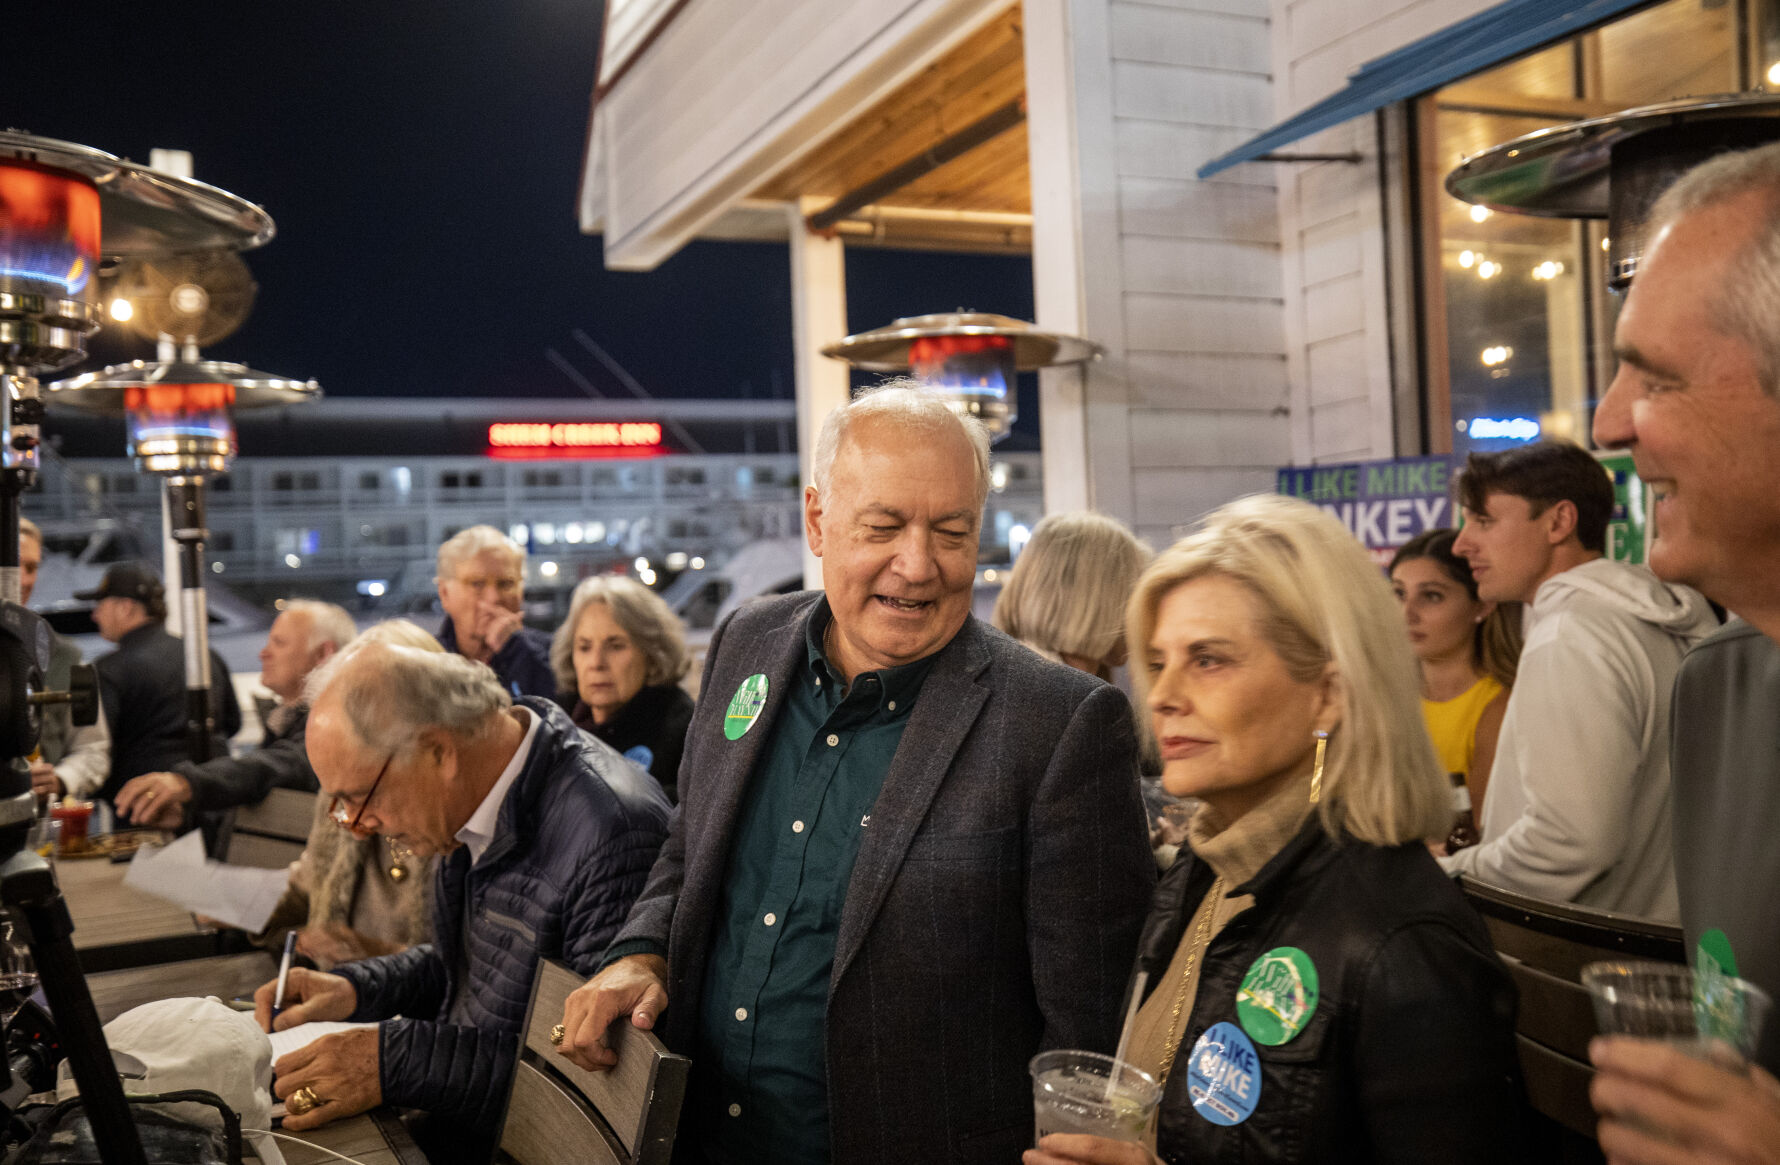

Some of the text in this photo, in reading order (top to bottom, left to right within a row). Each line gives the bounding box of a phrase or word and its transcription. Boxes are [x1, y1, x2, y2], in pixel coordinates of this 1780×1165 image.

[1296, 468, 1358, 501] LIKE
[1367, 461, 1447, 496] MIKE
[1218, 1034, 1256, 1075] LIKE
[1198, 1051, 1253, 1100] MIKE
